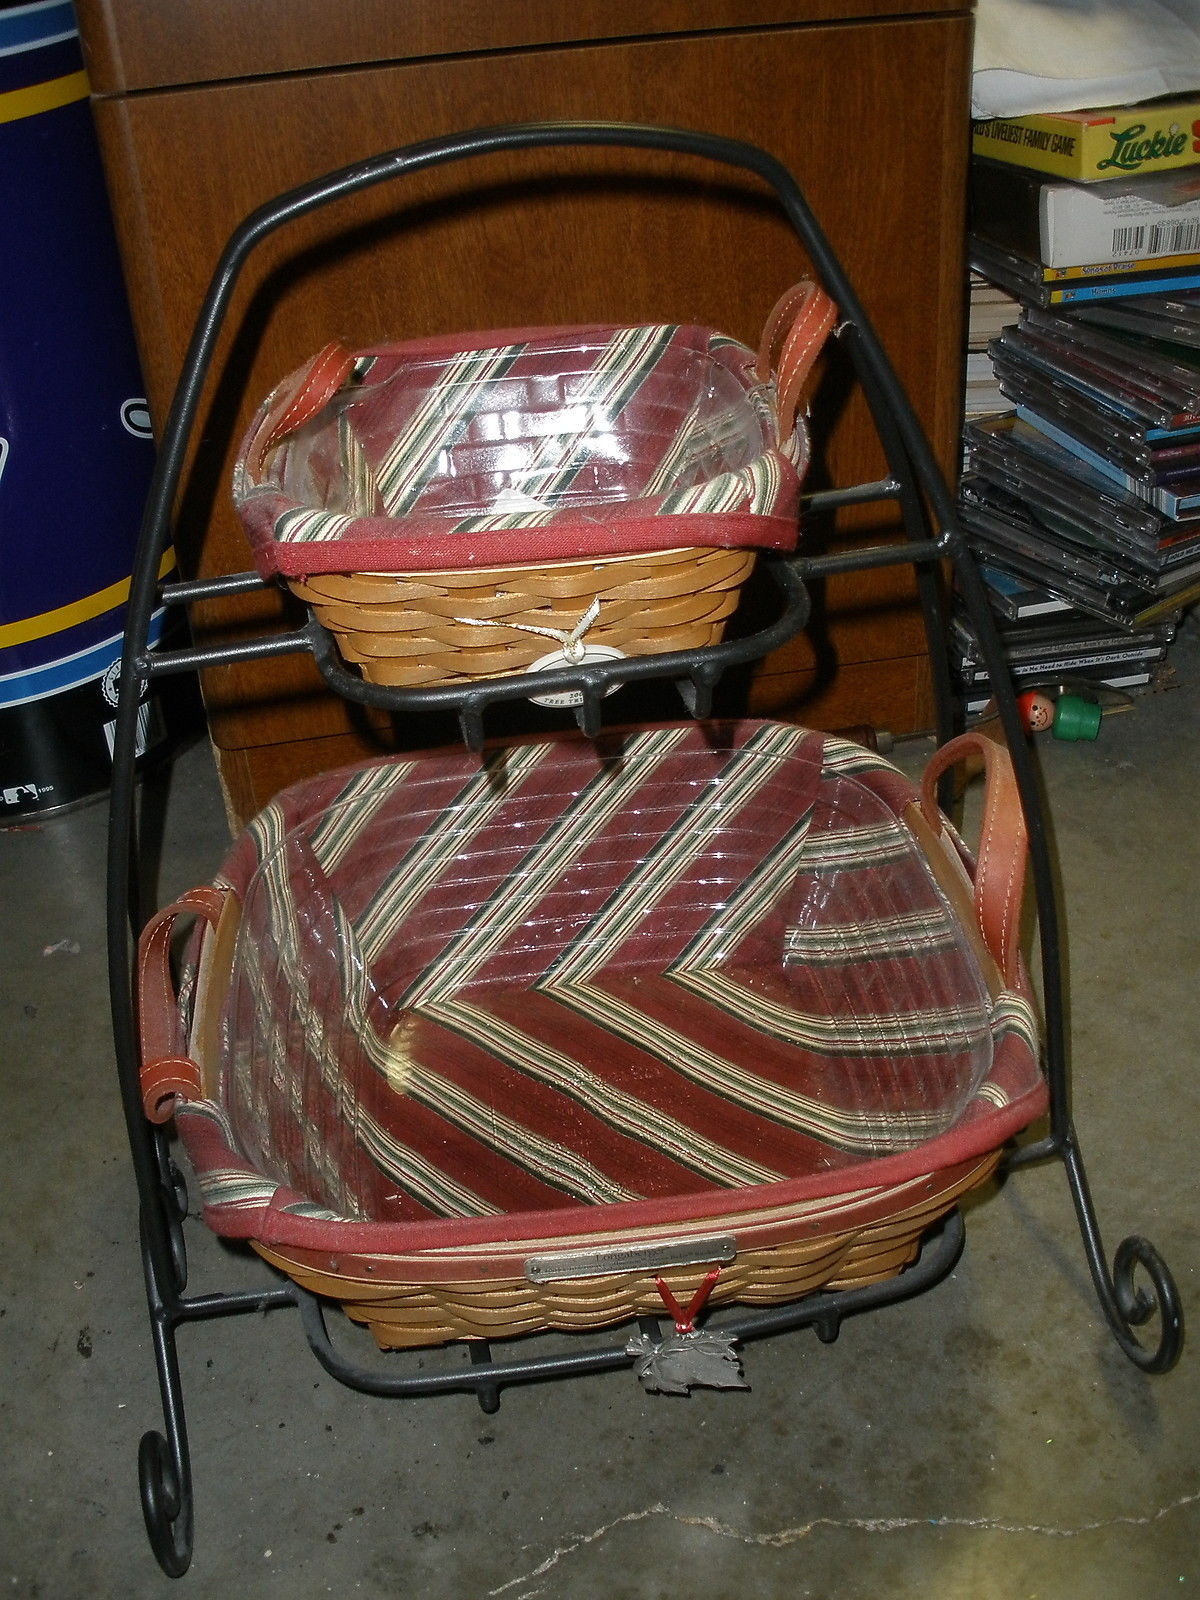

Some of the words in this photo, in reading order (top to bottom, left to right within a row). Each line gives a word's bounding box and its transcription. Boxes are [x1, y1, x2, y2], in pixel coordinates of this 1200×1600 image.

[1023, 129, 1051, 151] FAMILY
[1050, 134, 1077, 157] GAME
[1096, 124, 1188, 170] Luckie
[1115, 262, 1136, 272] Praise
[1079, 656, 1094, 664] When
[1122, 650, 1144, 659] Outside
